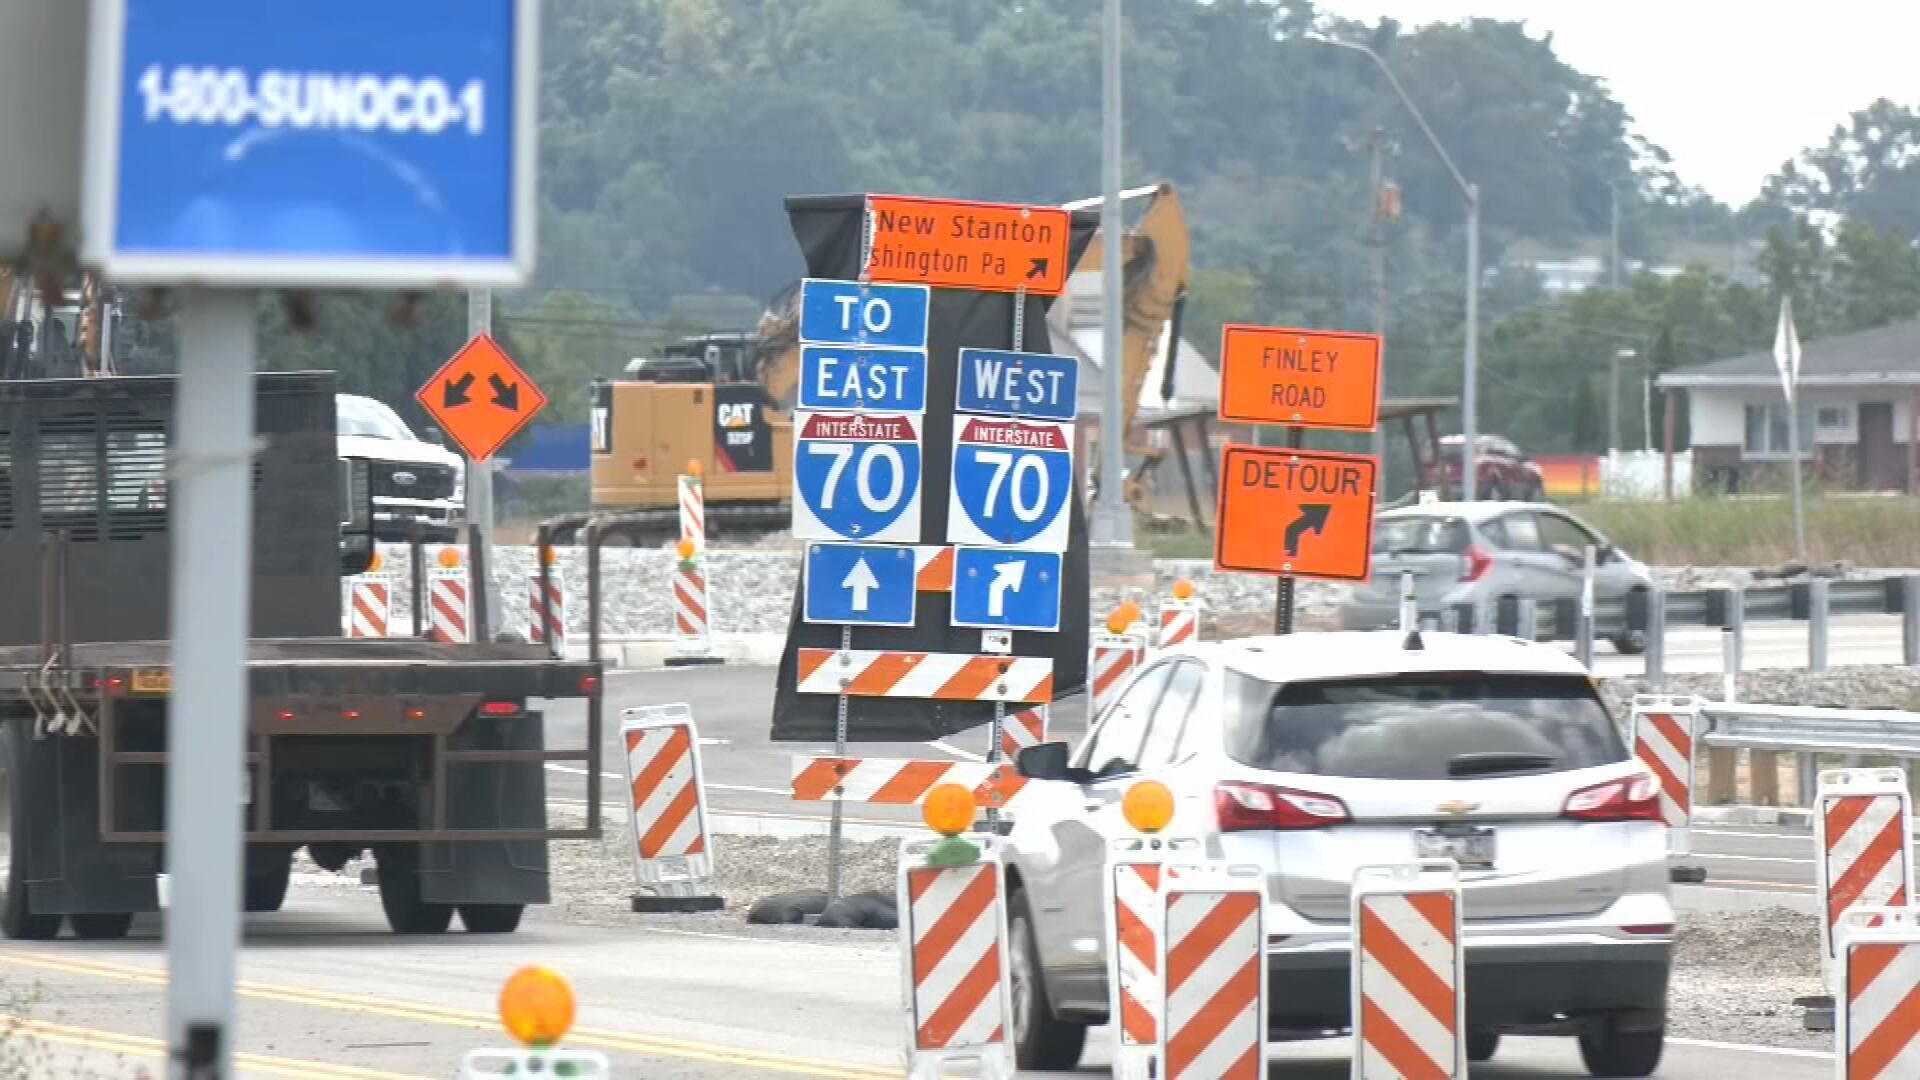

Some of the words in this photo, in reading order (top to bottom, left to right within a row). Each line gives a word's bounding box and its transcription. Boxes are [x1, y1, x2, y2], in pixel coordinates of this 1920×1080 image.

[138, 63, 484, 136] 1-800-SUNOCO-1
[879, 209, 935, 235] New
[951, 215, 1052, 243] Stanton
[871, 244, 968, 277] shington
[981, 253, 1006, 275] Pa
[834, 295, 892, 333] TO
[817, 357, 909, 400] EAST
[1262, 347, 1339, 373] FINLEY
[974, 359, 1065, 405] WEST
[1271, 383, 1326, 408] ROAD
[590, 407, 608, 449] AT
[717, 403, 754, 427] CAT
[816, 421, 901, 439] INTERSTATE
[973, 426, 1054, 447] INTERSTATE
[808, 443, 905, 513] 70
[974, 451, 1049, 523] 70
[1242, 459, 1361, 496] DETOUR
